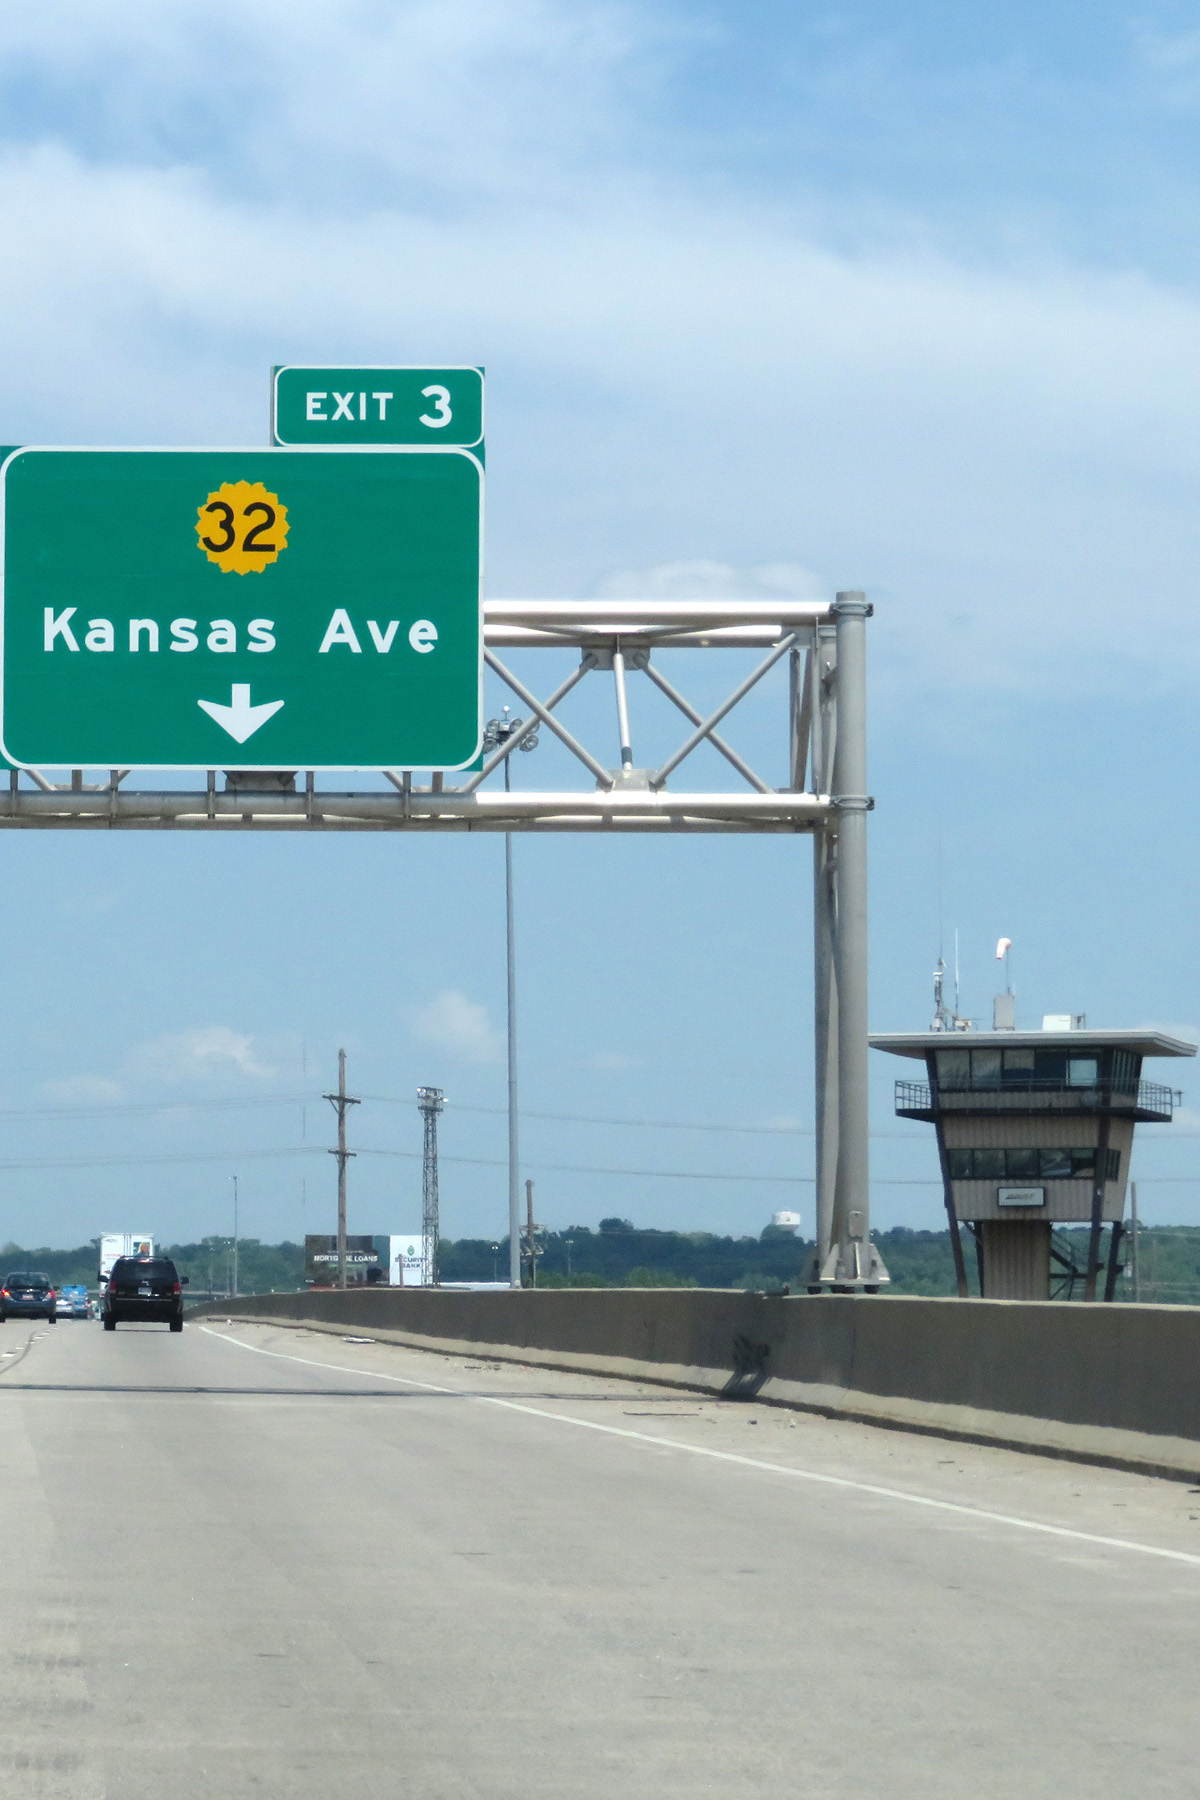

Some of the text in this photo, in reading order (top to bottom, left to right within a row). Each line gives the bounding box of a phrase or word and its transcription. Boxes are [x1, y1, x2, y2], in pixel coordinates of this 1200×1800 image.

[305, 384, 453, 429] EXIT 3
[201, 500, 277, 553] 32
[43, 606, 440, 655] Kansas Ave
